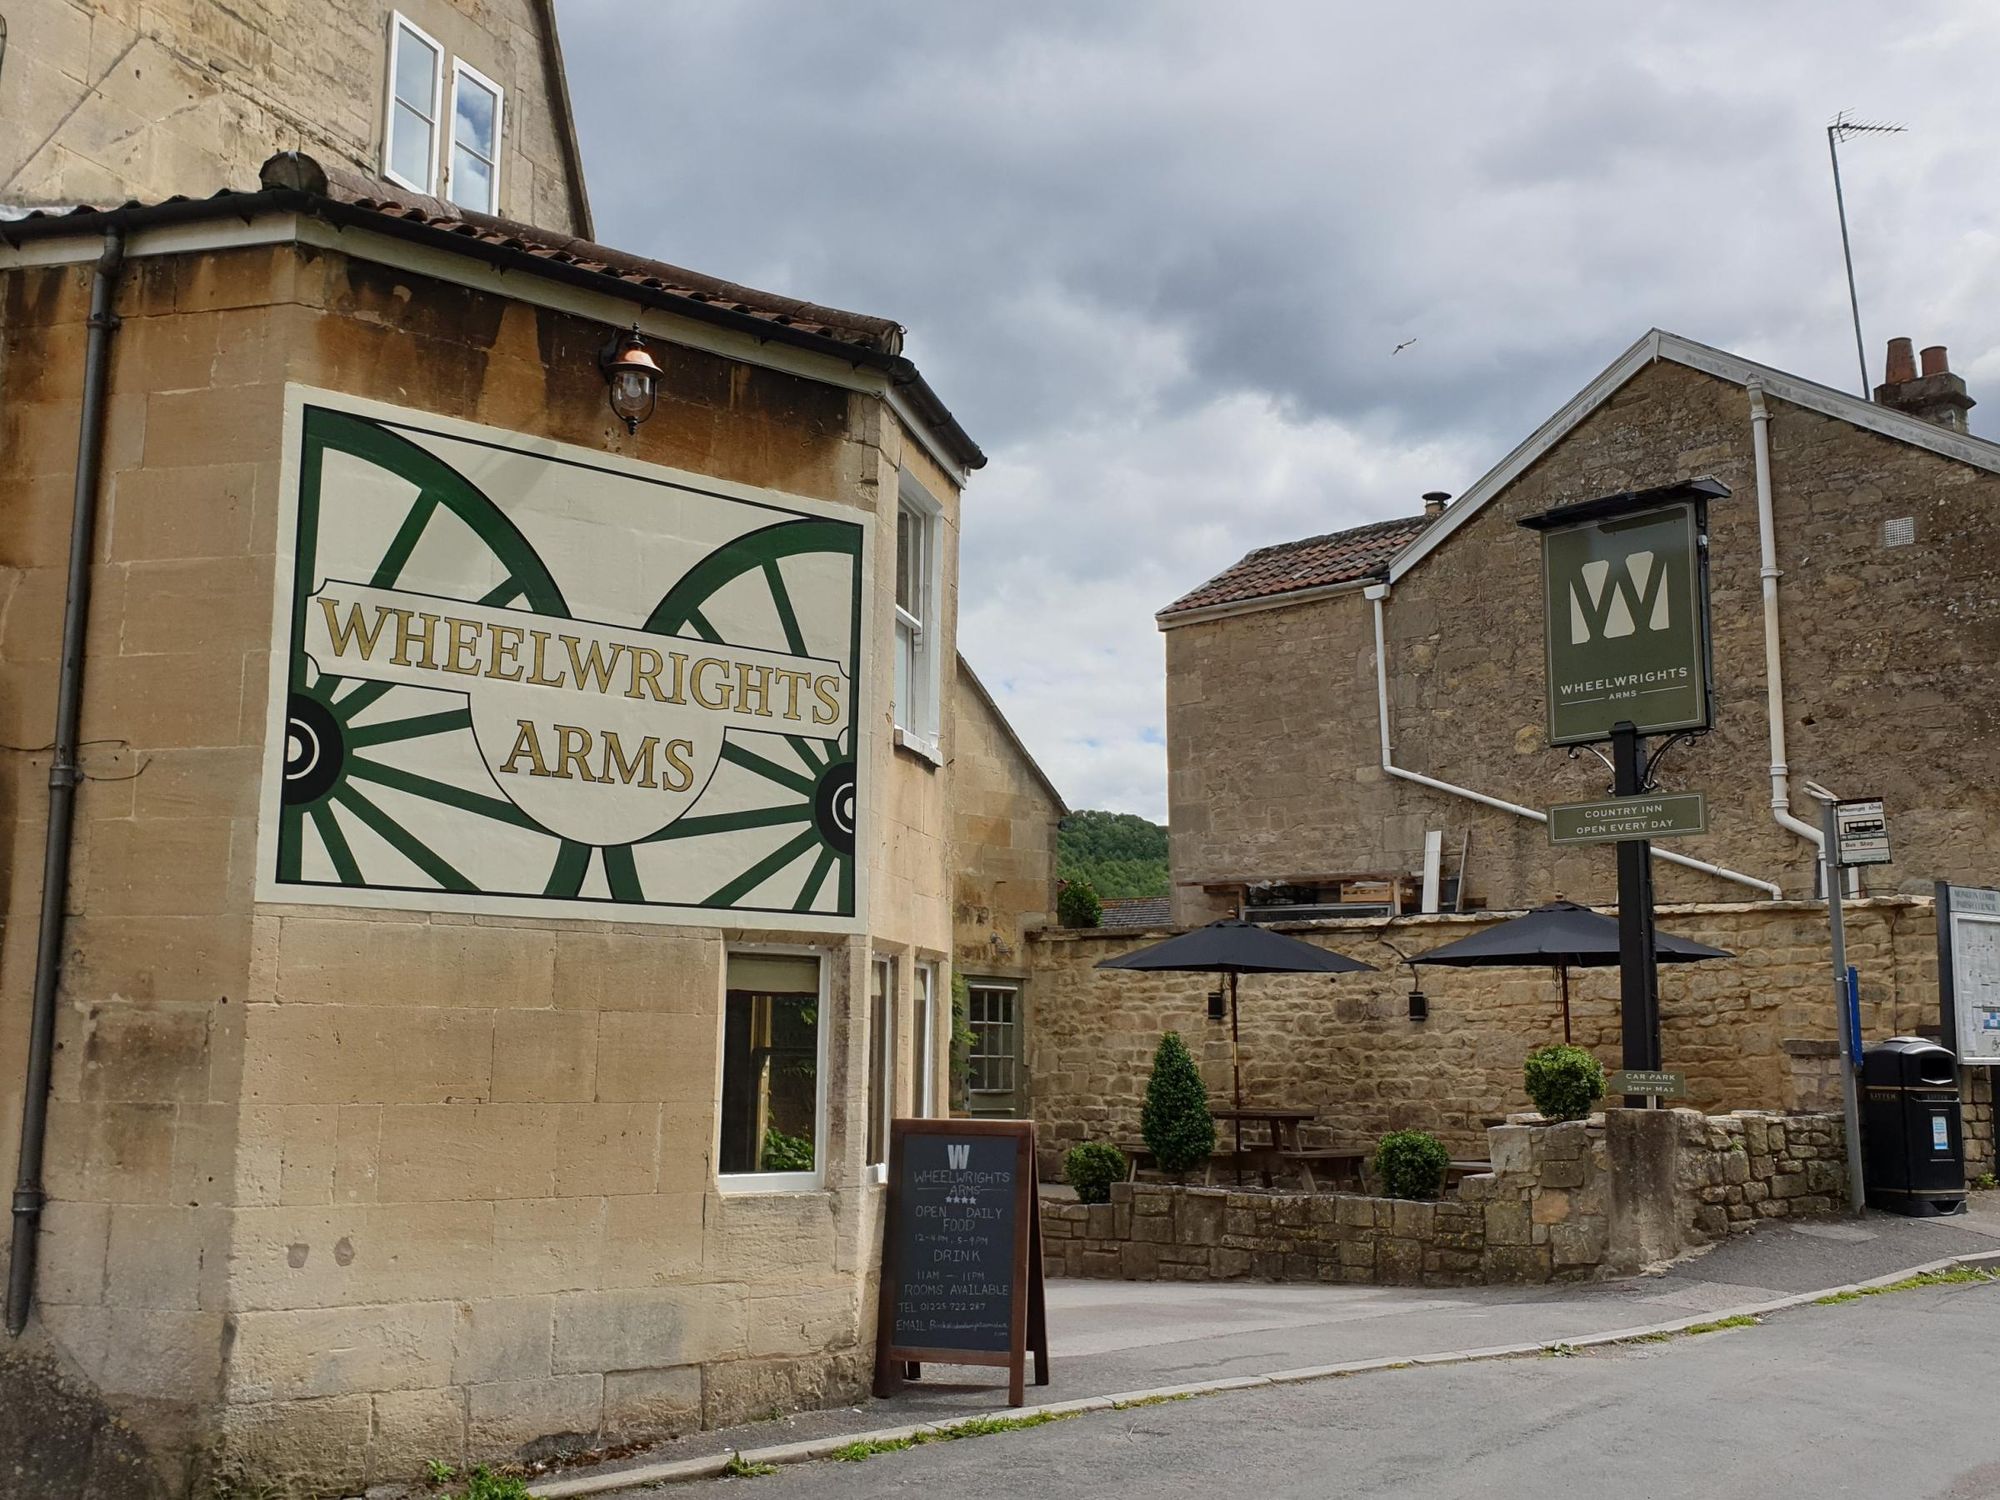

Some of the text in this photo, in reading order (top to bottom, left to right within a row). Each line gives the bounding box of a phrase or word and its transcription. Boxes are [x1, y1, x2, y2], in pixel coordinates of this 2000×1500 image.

[316, 596, 842, 726] WHEELWRIGHTS
[1560, 666, 1688, 695] WHEELWRIGHTS
[1608, 689, 1638, 701] ARMS
[499, 719, 694, 794] ARMS
[1585, 804, 1663, 818] COUNTRY INN
[1576, 819, 1674, 835] OPEN EVERY DAY
[1649, 1073, 1676, 1081] PARK
[947, 1144, 970, 1169] W
[913, 1169, 1010, 1184] WHEELWRIGHTS
[949, 1184, 981, 1196] ARMS
[915, 1205, 1003, 1219] OPEN DAILY
[943, 1218, 975, 1232] FOOD
[934, 1249, 981, 1262] DRINK
[904, 1284, 1009, 1297] ROOMS AVAILABLE
[897, 1302, 917, 1313] TEL
[896, 1319, 927, 1331] EMAIL
